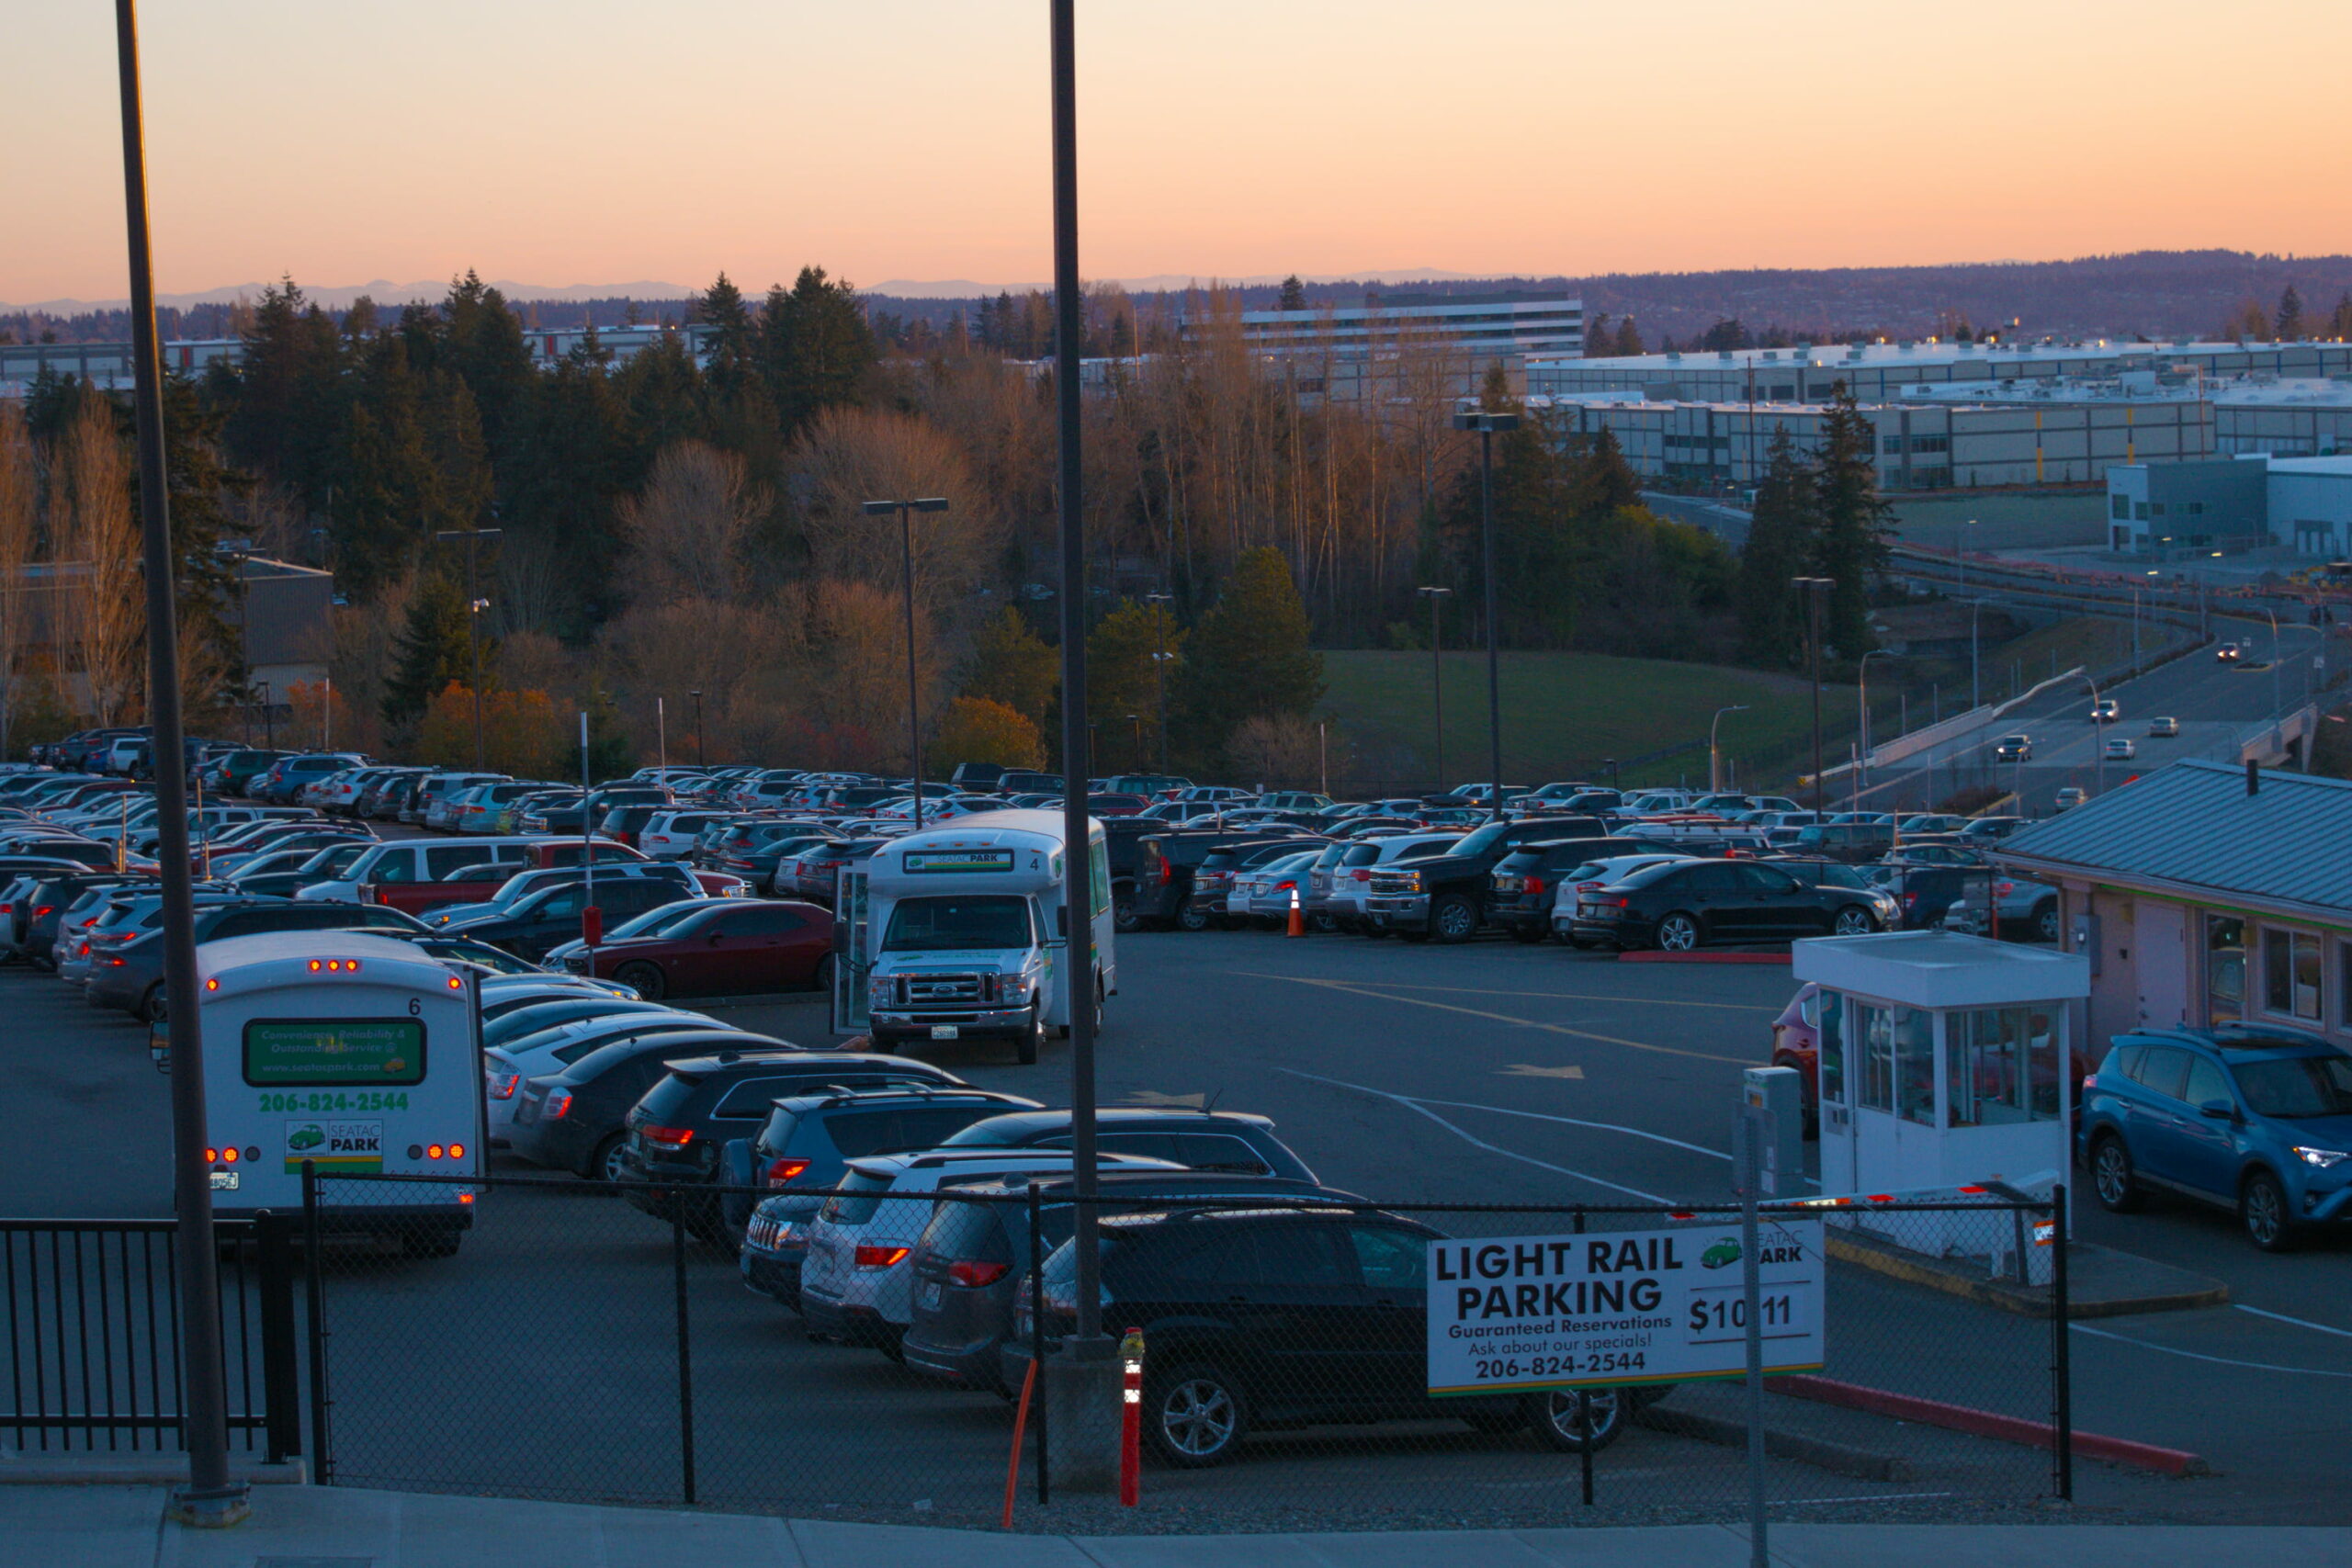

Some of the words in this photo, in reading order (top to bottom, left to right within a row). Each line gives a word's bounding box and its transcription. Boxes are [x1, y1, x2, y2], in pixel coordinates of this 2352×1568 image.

[970, 853, 998, 862] PARK
[1030, 858, 1039, 871] 4
[408, 998, 421, 1016] 6
[338, 1029, 394, 1040] Reliability
[398, 1029, 405, 1039] &
[271, 1043, 339, 1055] Outstanding
[343, 1043, 382, 1053] Service
[262, 1061, 379, 1074] www.seatacpark.com
[259, 1092, 409, 1112] 206-824-2544
[331, 1124, 380, 1137] SEATAC
[331, 1138, 379, 1151] PARK
[1758, 1229, 1804, 1247] EATAC
[1436, 1242, 1571, 1281] LIGHT
[1589, 1237, 1683, 1274] RAIL
[1758, 1246, 1803, 1265] ARK
[1457, 1278, 1662, 1321] PARKING
[1448, 1319, 1555, 1340] Guaranteed
[1561, 1314, 1672, 1334] Reservations
[1468, 1340, 1495, 1357] Ask
[1502, 1338, 1548, 1354] about
[1553, 1338, 1580, 1352] our
[1584, 1332, 1652, 1353] specials!
[1475, 1352, 1645, 1379] 206-824-2544
